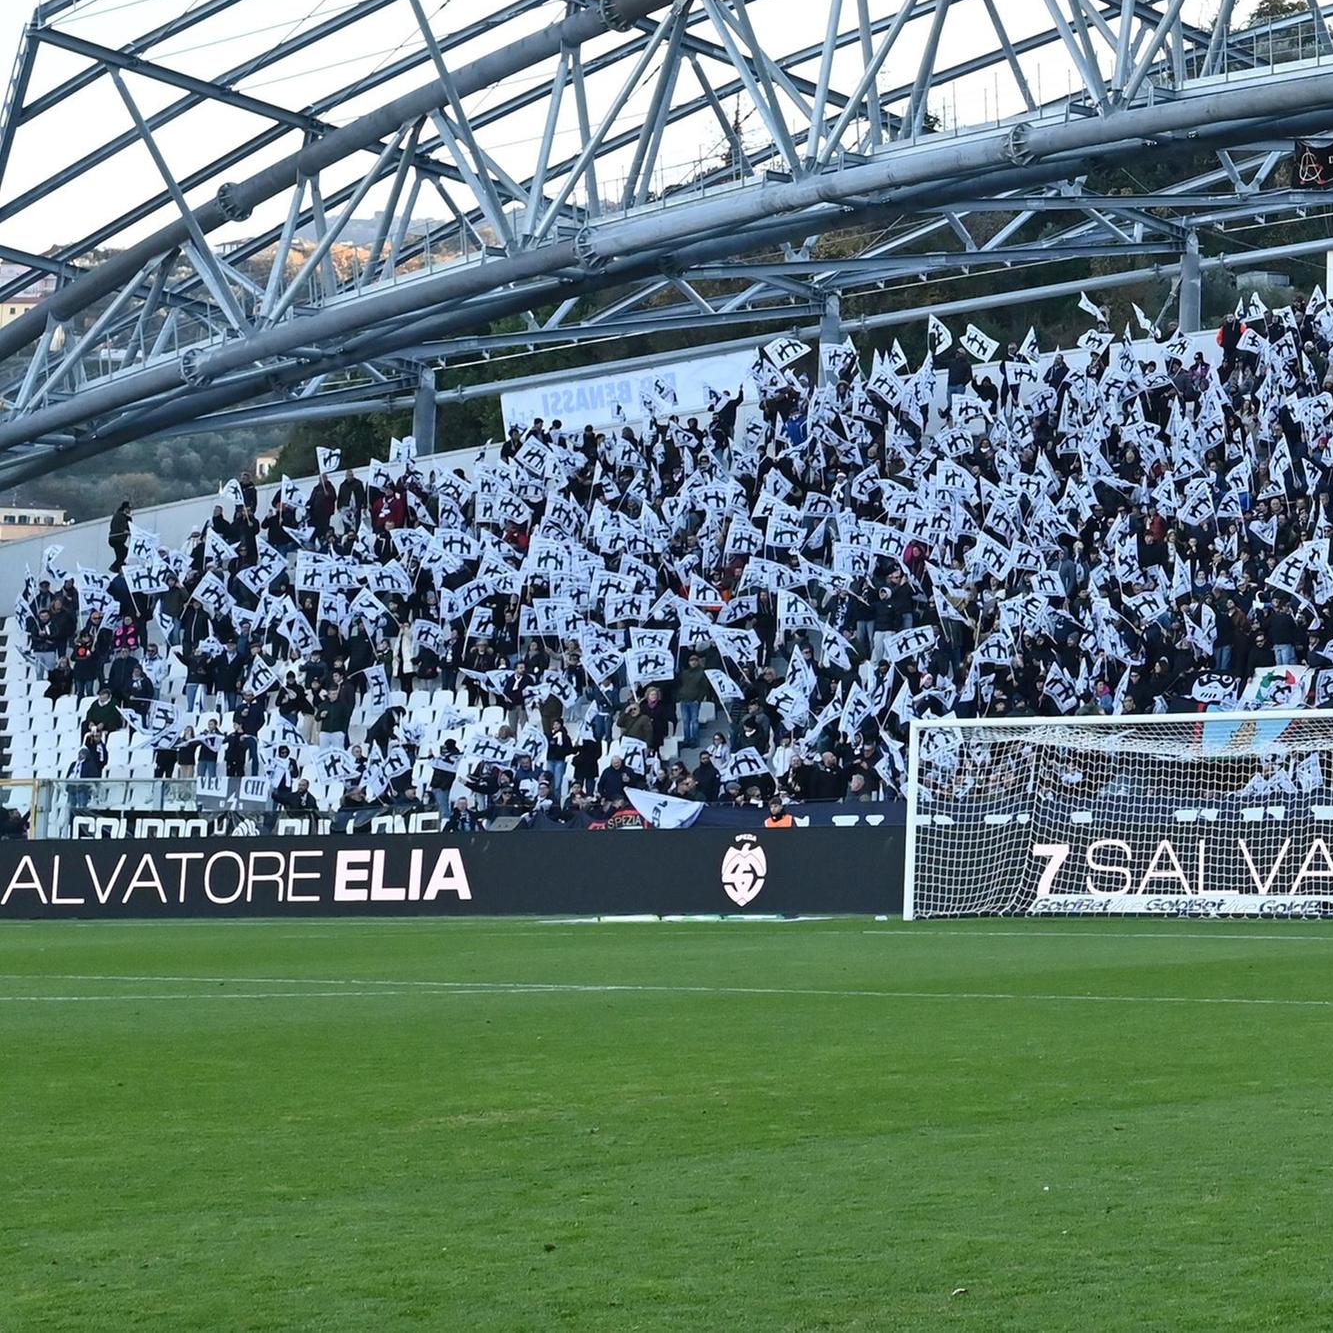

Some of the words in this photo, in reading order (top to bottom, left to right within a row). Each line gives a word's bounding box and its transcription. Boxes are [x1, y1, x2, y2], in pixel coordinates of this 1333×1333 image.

[244, 779, 265, 796] CHI
[608, 815, 641, 829] SPEZIA
[1, 850, 324, 904] ALVATORE
[334, 849, 471, 901] ELIA
[1032, 844, 1070, 896] 7
